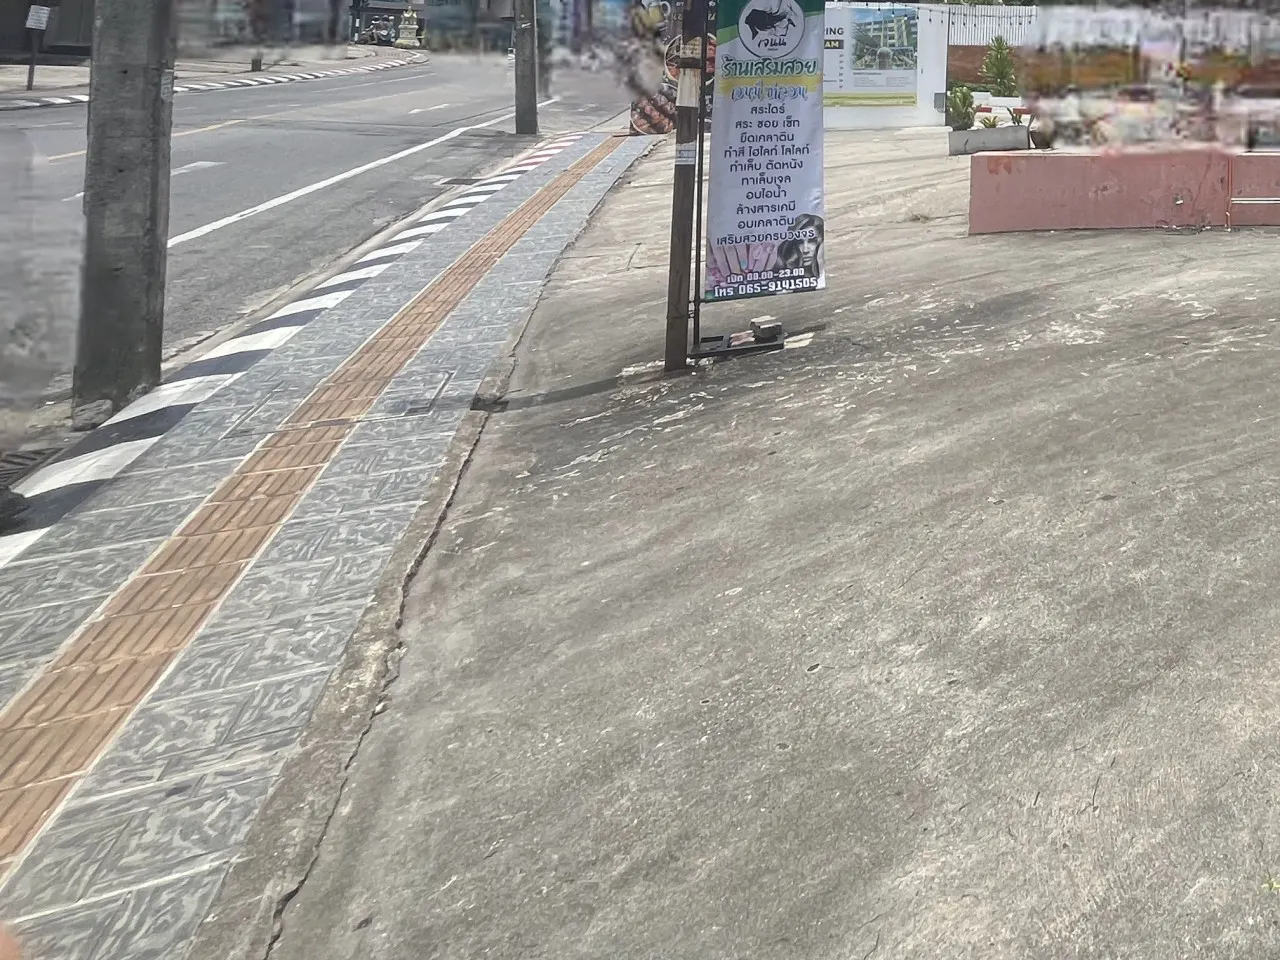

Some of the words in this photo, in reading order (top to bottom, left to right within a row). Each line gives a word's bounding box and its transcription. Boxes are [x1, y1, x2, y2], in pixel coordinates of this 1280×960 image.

[721, 54, 818, 78] ร้านเสริมสวย
